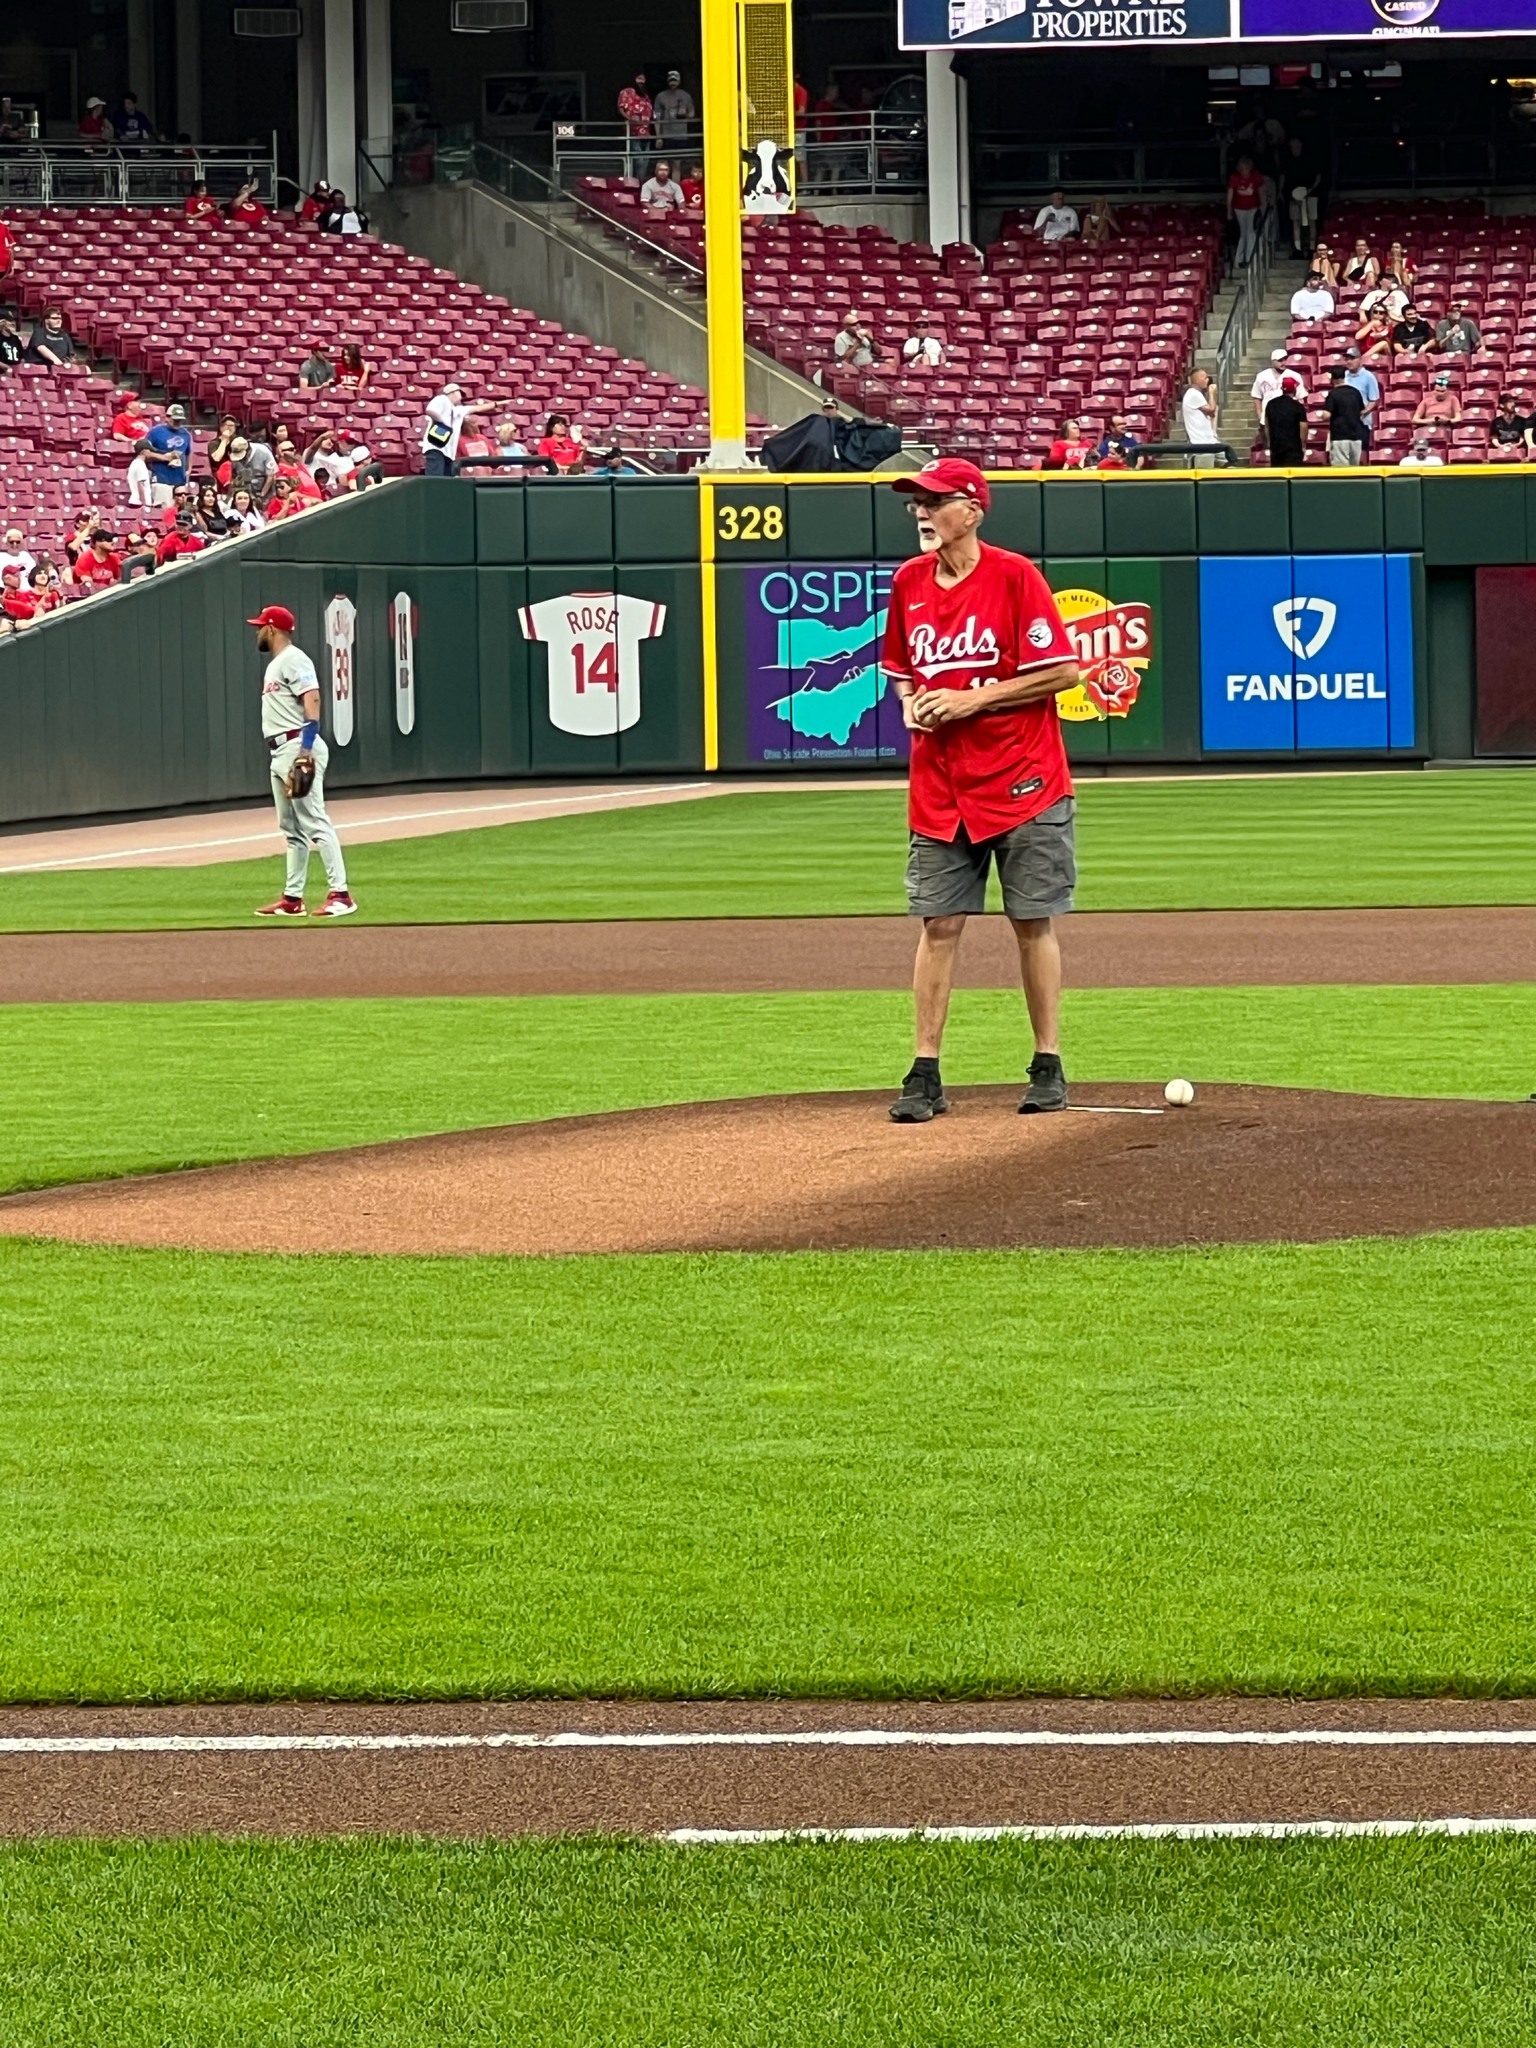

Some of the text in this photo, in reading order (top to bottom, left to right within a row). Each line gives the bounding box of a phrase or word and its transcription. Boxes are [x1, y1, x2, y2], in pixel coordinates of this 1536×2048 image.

[1031, 9, 1188, 38] PROPERTIES
[557, 125, 575, 135] 106
[718, 505, 784, 540] 328
[759, 570, 894, 615] OSPF
[566, 606, 620, 635] ROSE
[909, 615, 1000, 668] Reds
[1065, 612, 1149, 662] hn's
[571, 641, 620, 694] 14
[1226, 672, 1387, 701] FANDUEL
[783, 748, 810, 760] Sucide
